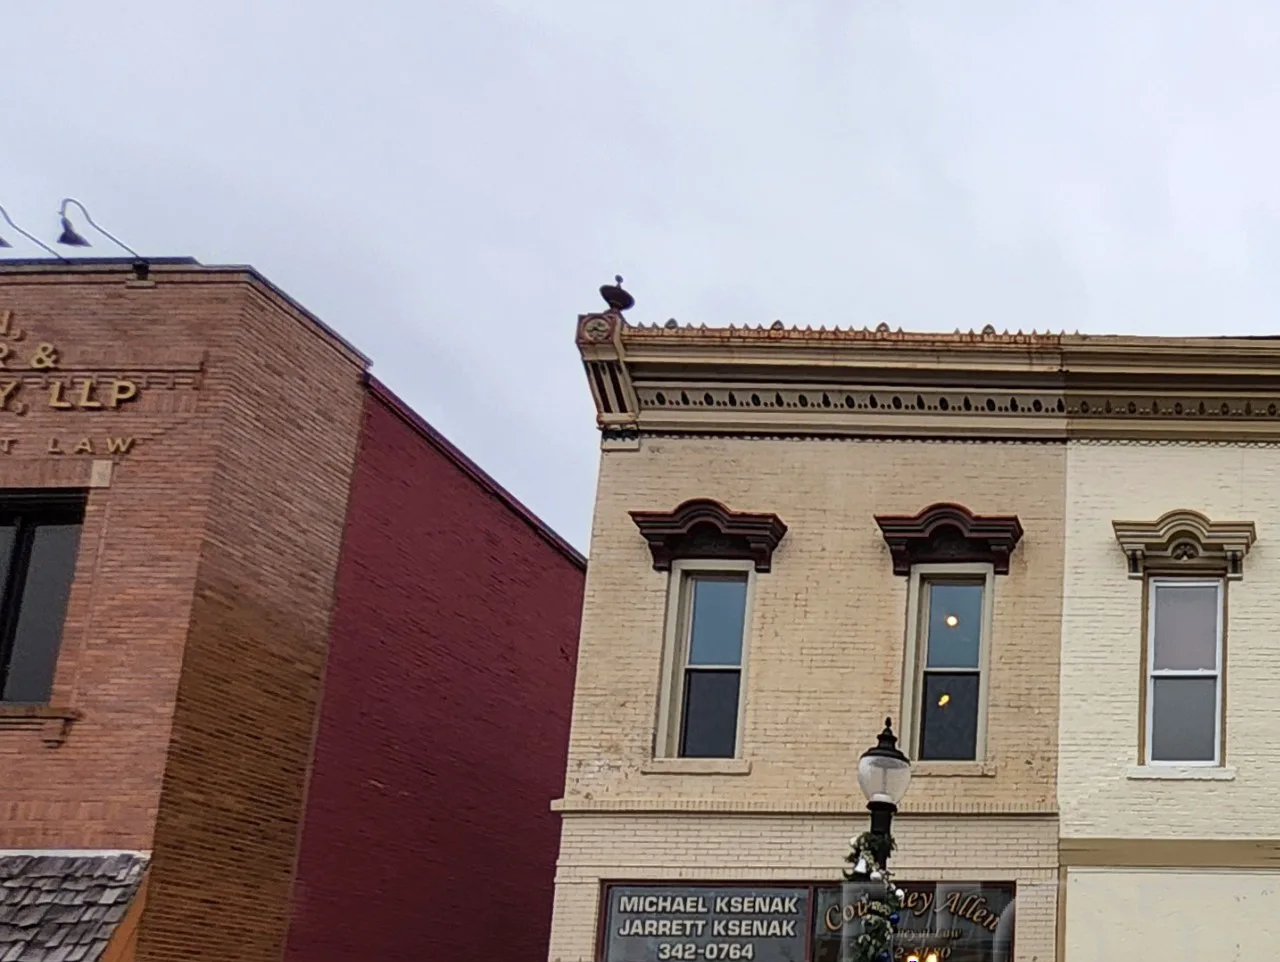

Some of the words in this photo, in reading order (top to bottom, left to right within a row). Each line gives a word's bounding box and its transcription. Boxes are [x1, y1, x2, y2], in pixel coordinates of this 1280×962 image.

[31, 342, 56, 369] &
[50, 379, 137, 408] LLP
[48, 437, 134, 453] LAW
[619, 896, 708, 913] MICHAEL
[715, 896, 798, 913] KSENAK
[825, 891, 933, 931] Couney
[934, 892, 1001, 930] Allen
[618, 920, 706, 936] JARRETT
[713, 920, 796, 936] KSENAK
[658, 943, 754, 960] 342-0764
